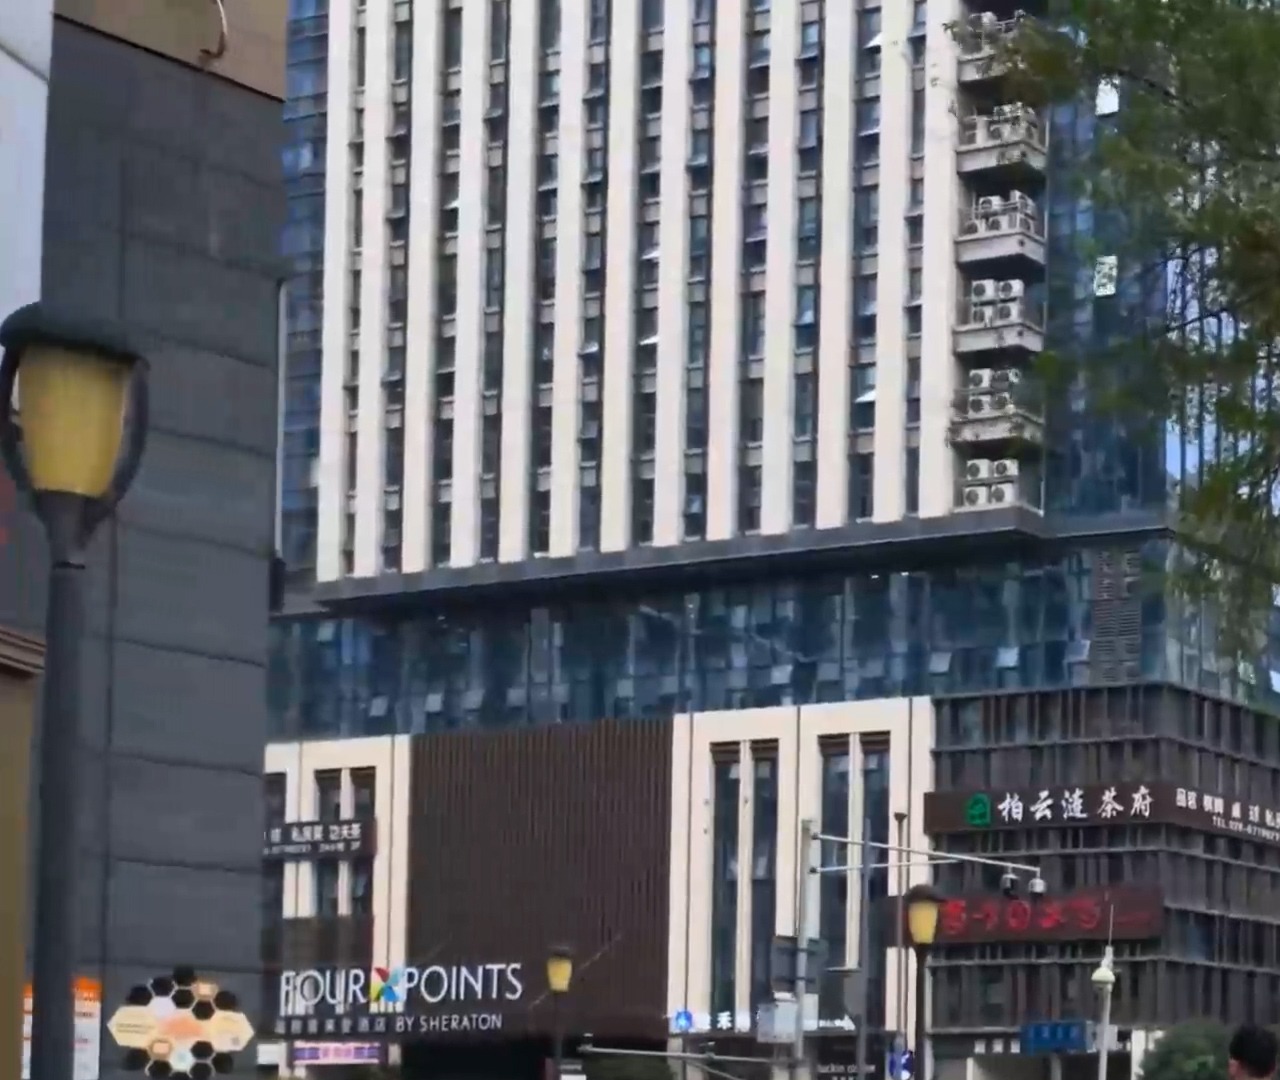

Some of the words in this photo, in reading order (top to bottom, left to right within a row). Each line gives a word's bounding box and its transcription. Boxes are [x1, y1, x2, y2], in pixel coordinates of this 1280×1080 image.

[280, 968, 367, 1006] FOUR
[404, 963, 523, 1003] POINTS
[395, 1016, 414, 1033] BY
[420, 1014, 503, 1032] SHERATON
